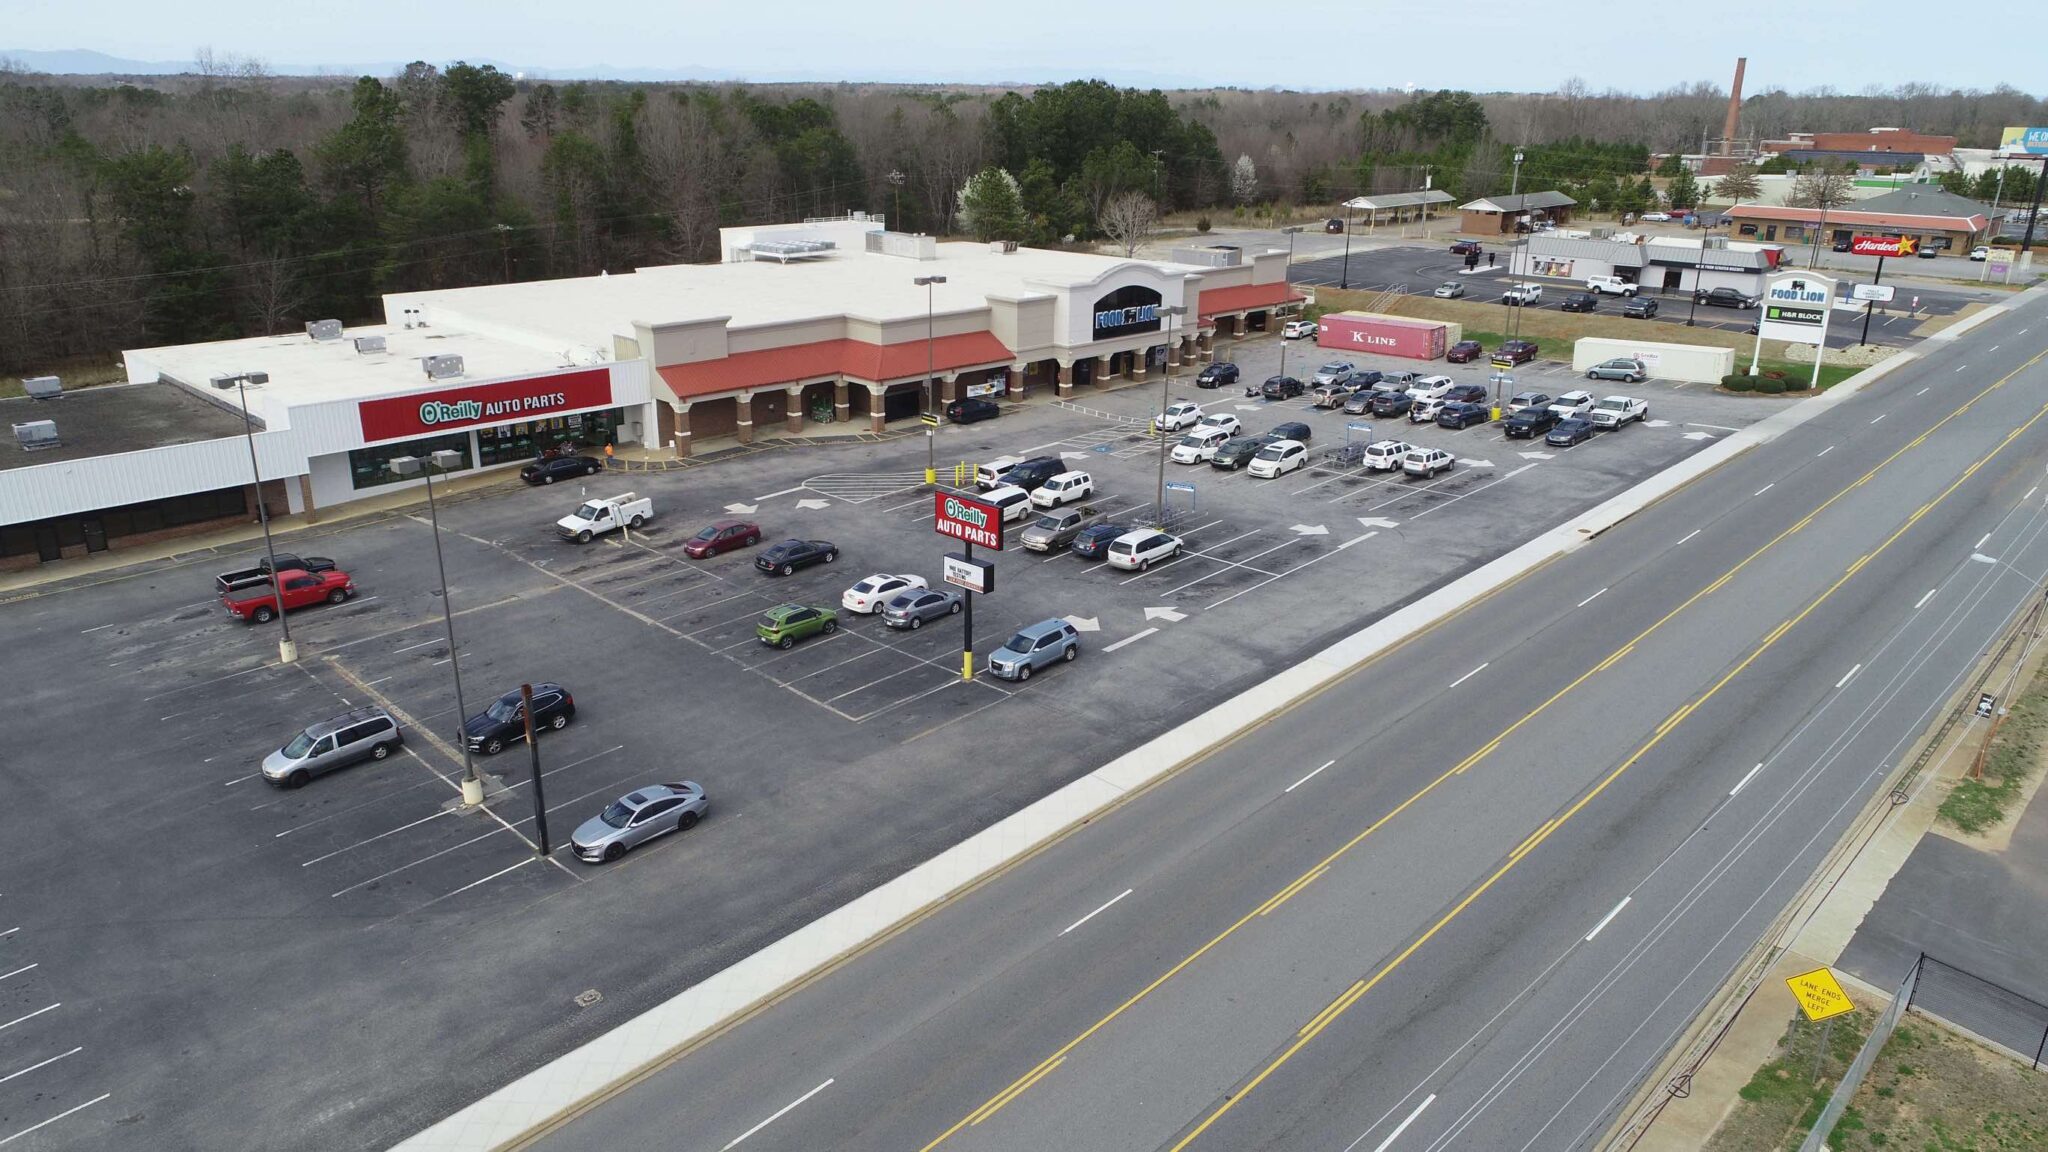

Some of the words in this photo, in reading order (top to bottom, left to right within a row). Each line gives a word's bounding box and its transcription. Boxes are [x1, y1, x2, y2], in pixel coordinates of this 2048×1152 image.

[1771, 288, 1798, 300] FOOD
[1800, 291, 1825, 302] LION
[1095, 309, 1121, 329] FOOD
[1798, 312, 1822, 320] BLOCK
[1350, 330, 1368, 342] K
[1367, 338, 1397, 346] LINE
[420, 401, 482, 424] O'Reilly
[485, 399, 520, 416] AUTO
[523, 392, 565, 409] PARTS
[945, 498, 987, 528] O'Reilly
[937, 518, 962, 536] AUTO
[965, 526, 997, 546] PARTS
[1800, 980, 1819, 992] LANE
[1822, 988, 1841, 1000] ENDS
[1806, 991, 1830, 1006] MERGE
[1807, 1002, 1824, 1013] LEFT
